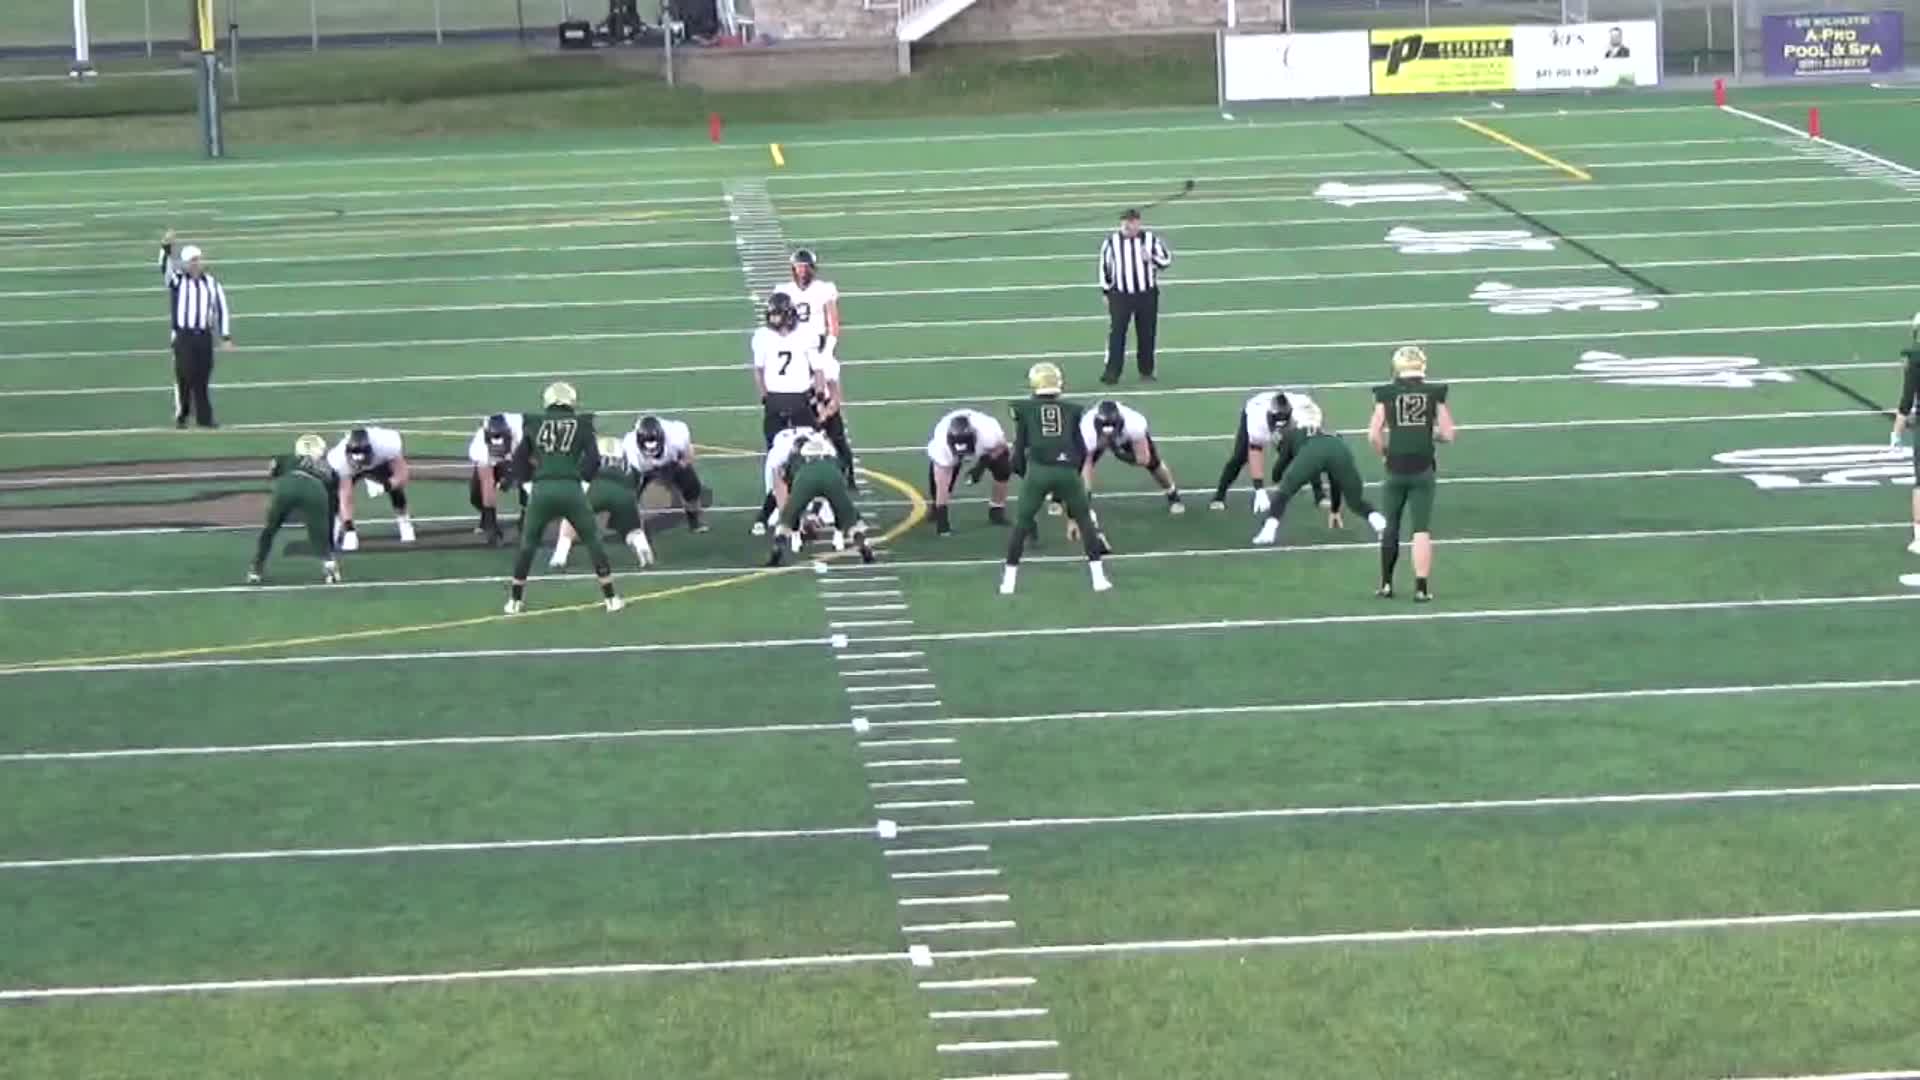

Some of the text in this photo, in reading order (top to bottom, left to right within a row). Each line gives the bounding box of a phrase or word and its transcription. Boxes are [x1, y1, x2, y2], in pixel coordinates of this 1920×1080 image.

[1783, 41, 1882, 58] POOL & SPA
[777, 350, 793, 376] 7
[1040, 404, 1062, 437] 9
[1395, 393, 1426, 426] 12
[536, 419, 578, 453] 47
